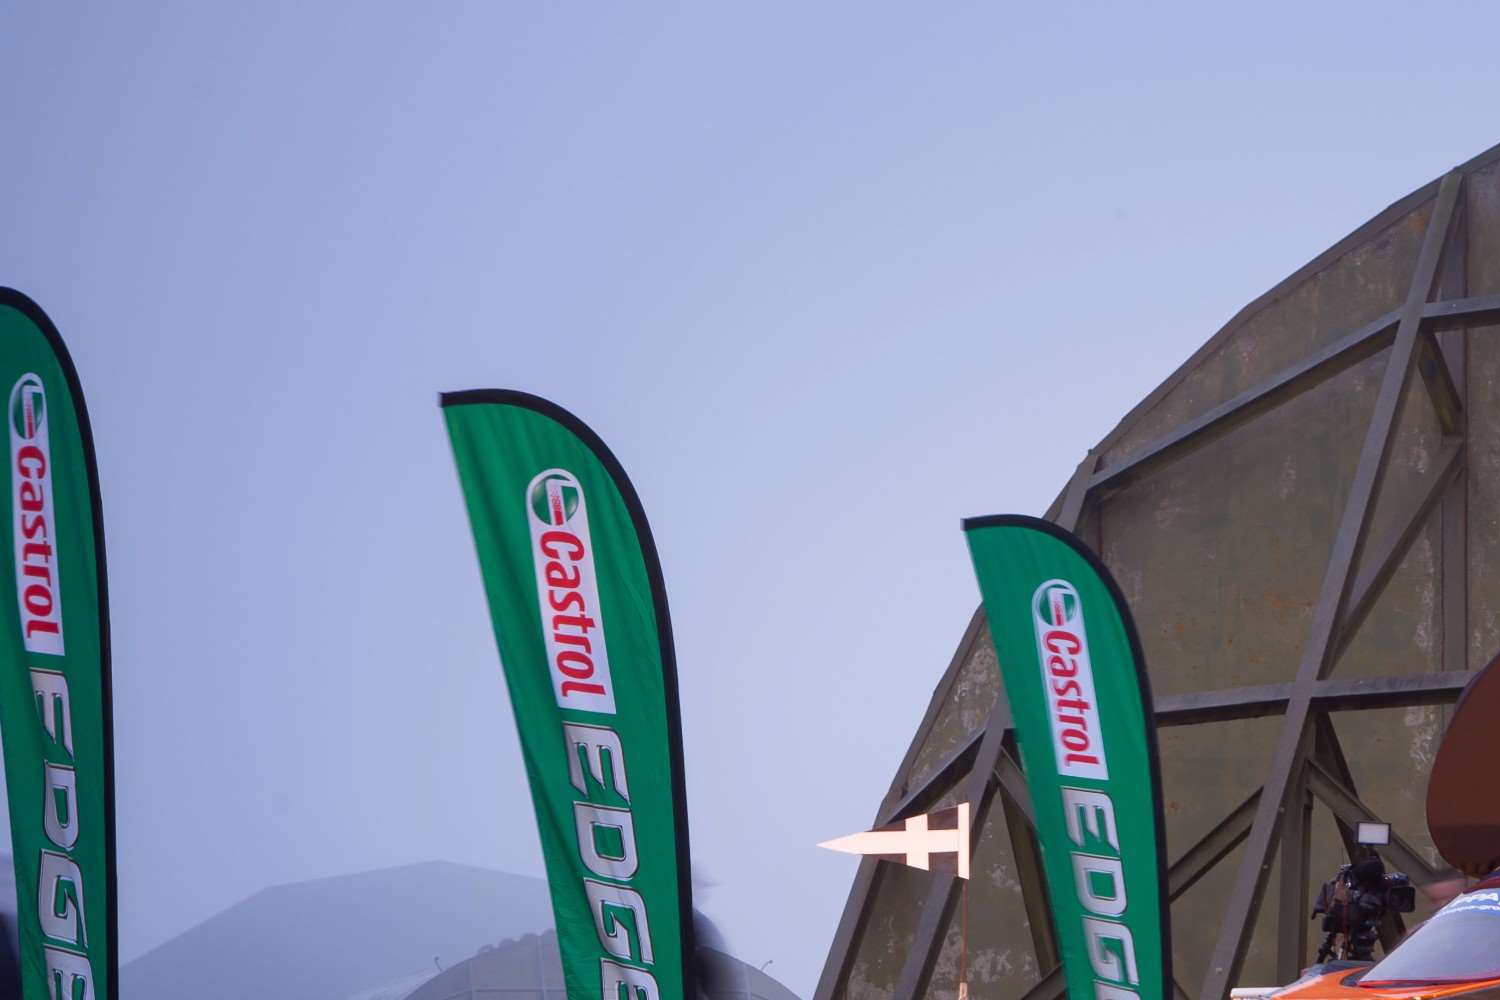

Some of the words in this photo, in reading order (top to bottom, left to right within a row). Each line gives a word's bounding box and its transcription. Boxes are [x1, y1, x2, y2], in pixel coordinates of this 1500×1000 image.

[17, 445, 59, 639] Castrol
[540, 530, 606, 698] Castrol
[1043, 631, 1100, 766] Castrol
